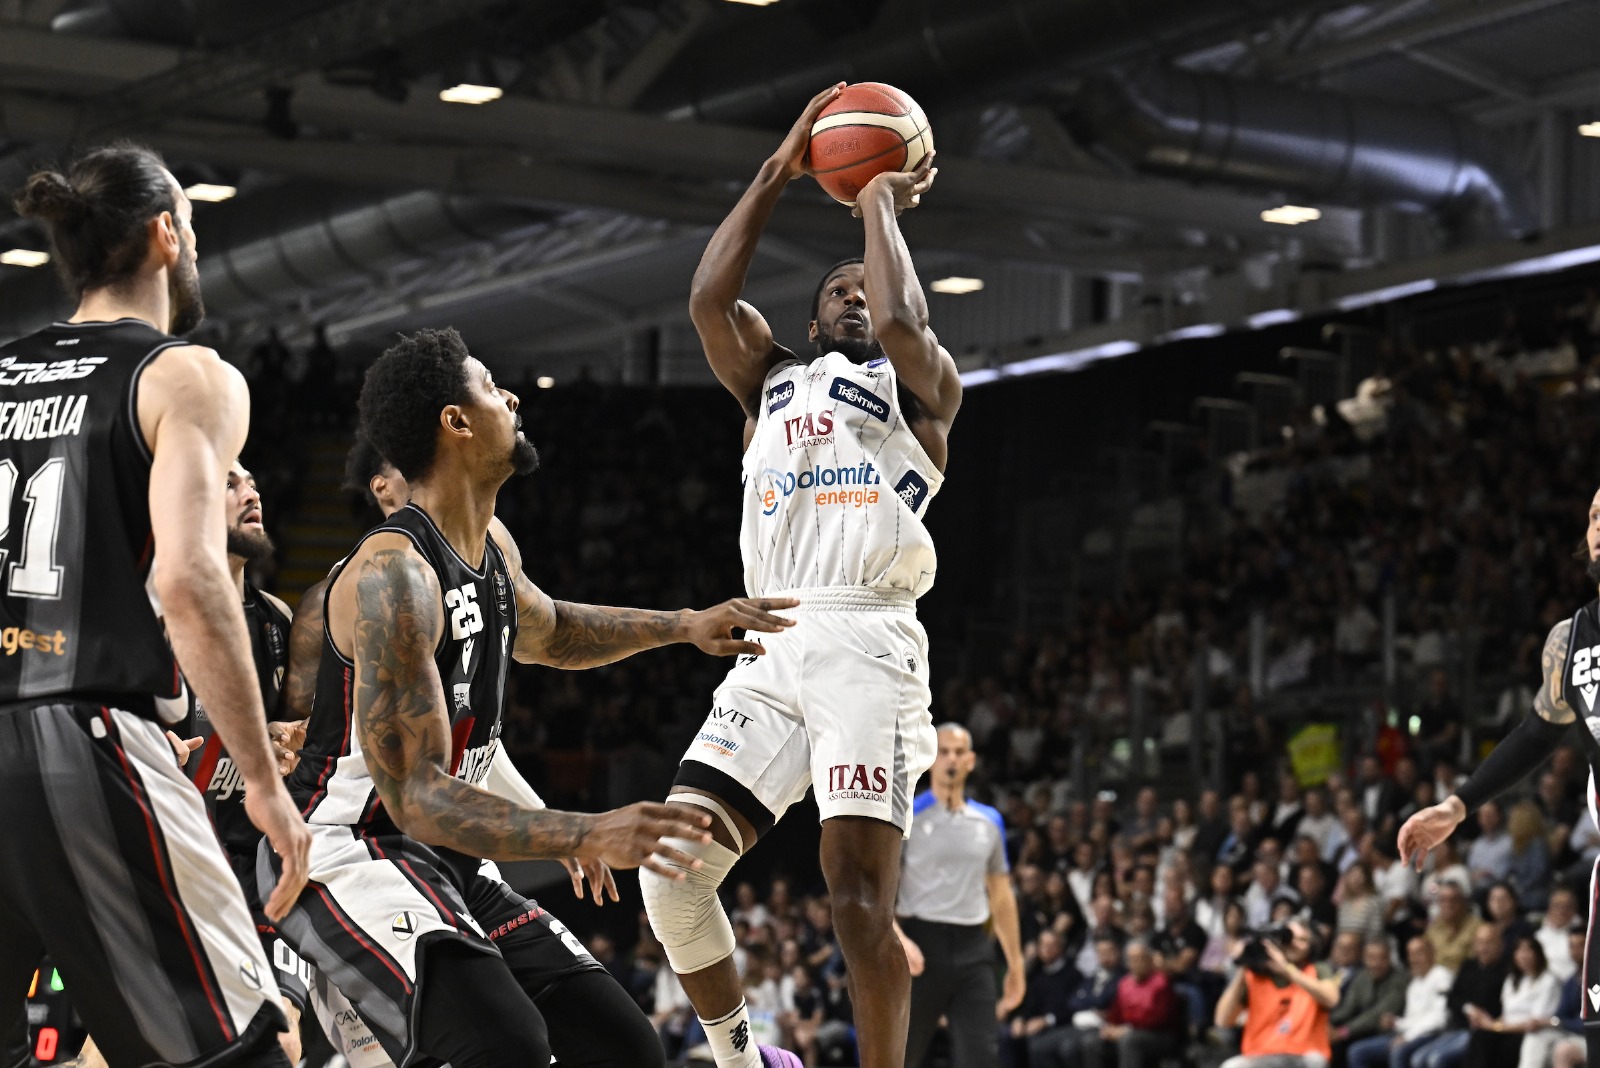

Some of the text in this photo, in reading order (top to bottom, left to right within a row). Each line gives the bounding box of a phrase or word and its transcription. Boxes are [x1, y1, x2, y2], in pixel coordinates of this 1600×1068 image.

[838, 384, 884, 414] TRENTINO
[0, 395, 88, 441] ENGELIA
[784, 409, 834, 446] ITAS
[783, 462, 881, 497] Dolomiti
[816, 488, 879, 508] energia
[445, 582, 484, 640] 25
[0, 626, 66, 656] gest
[703, 742, 735, 757] energia
[829, 764, 888, 793] ITAS
